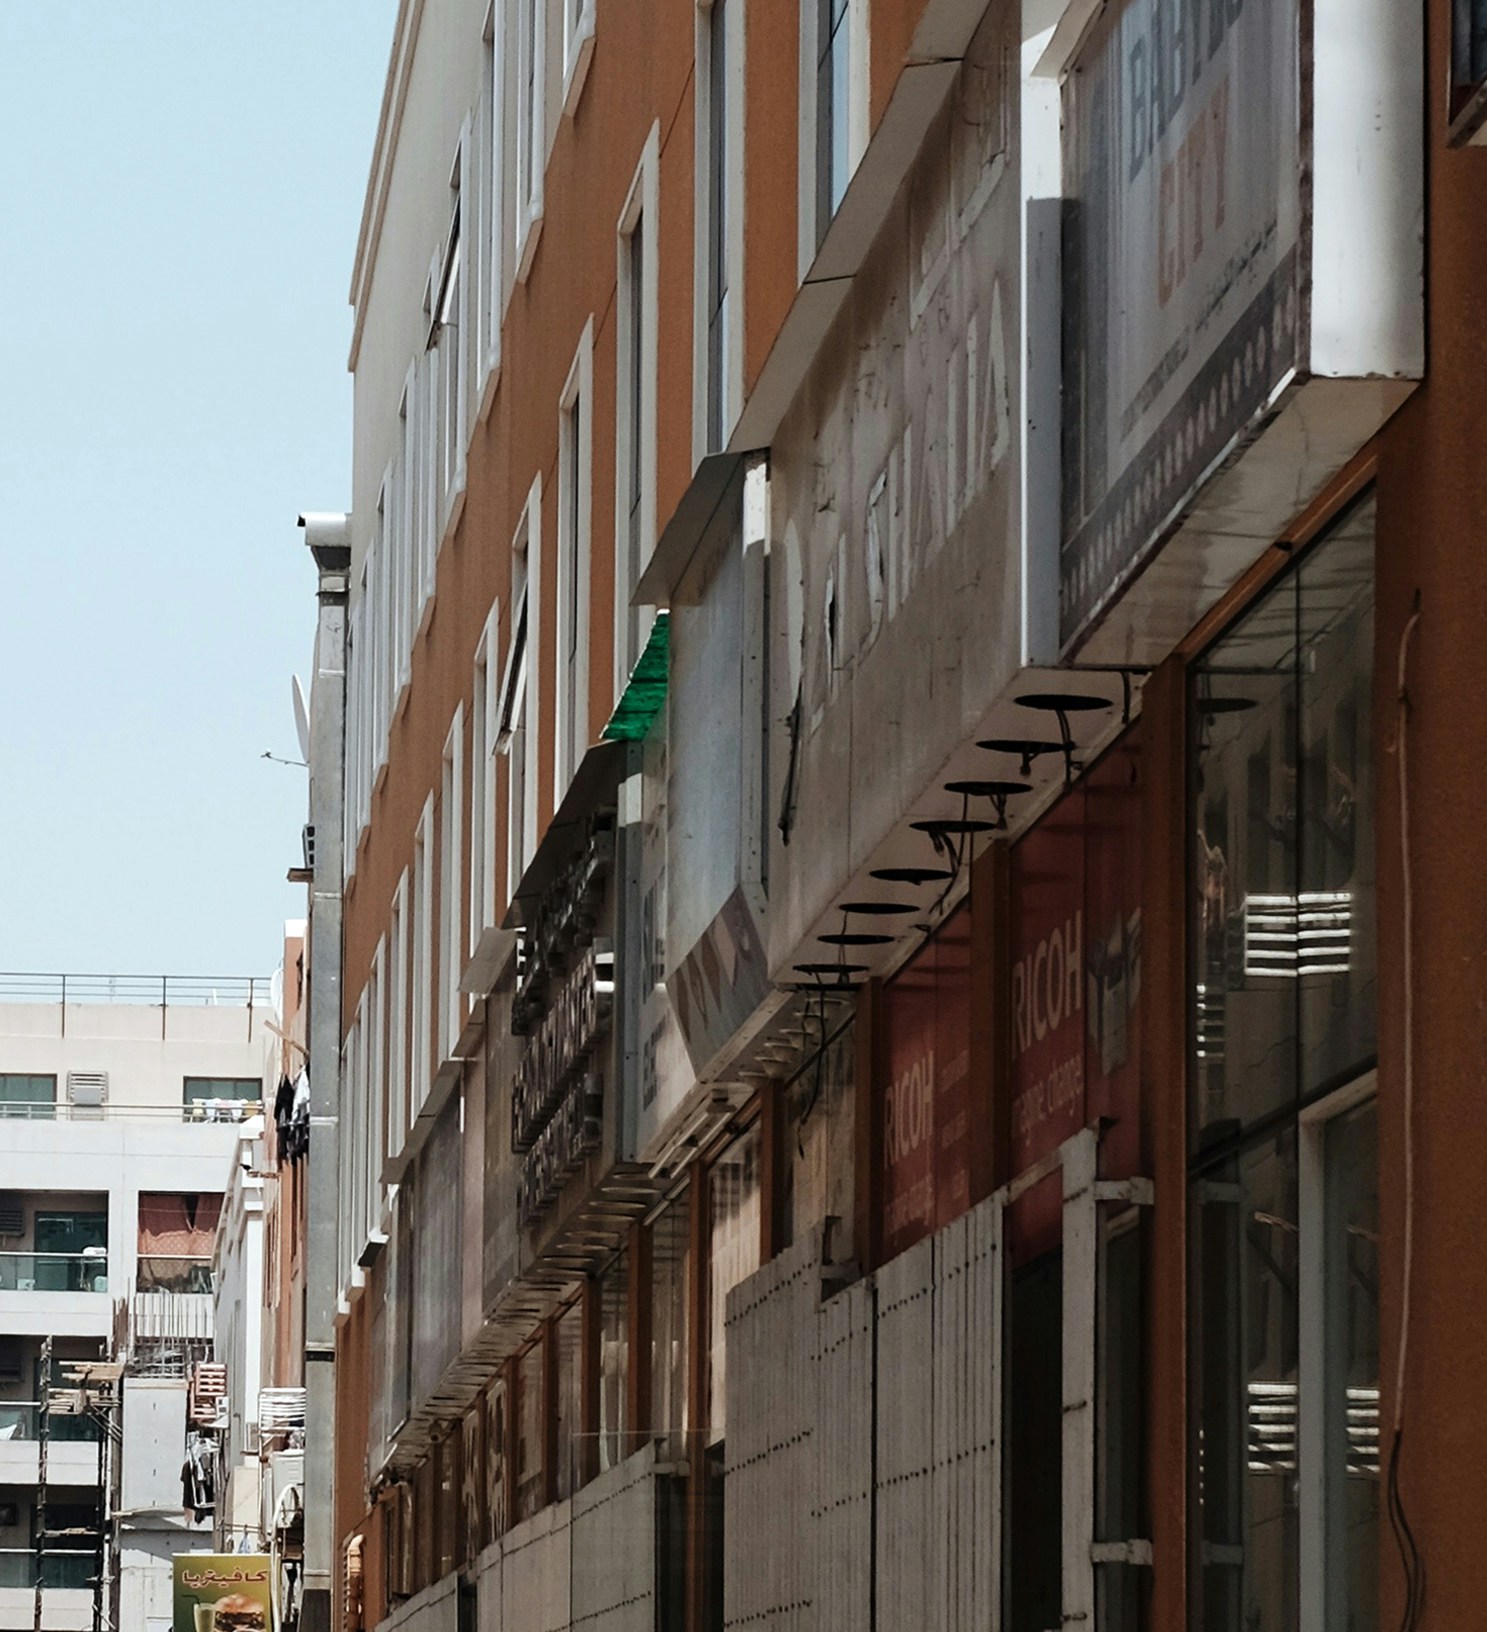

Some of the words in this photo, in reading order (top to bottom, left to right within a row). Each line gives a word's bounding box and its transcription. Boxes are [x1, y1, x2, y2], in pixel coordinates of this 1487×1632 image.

[1012, 910, 1083, 1060] RICOH
[883, 1050, 934, 1170] RICOH
[181, 1566, 269, 1589] كافيتريا
